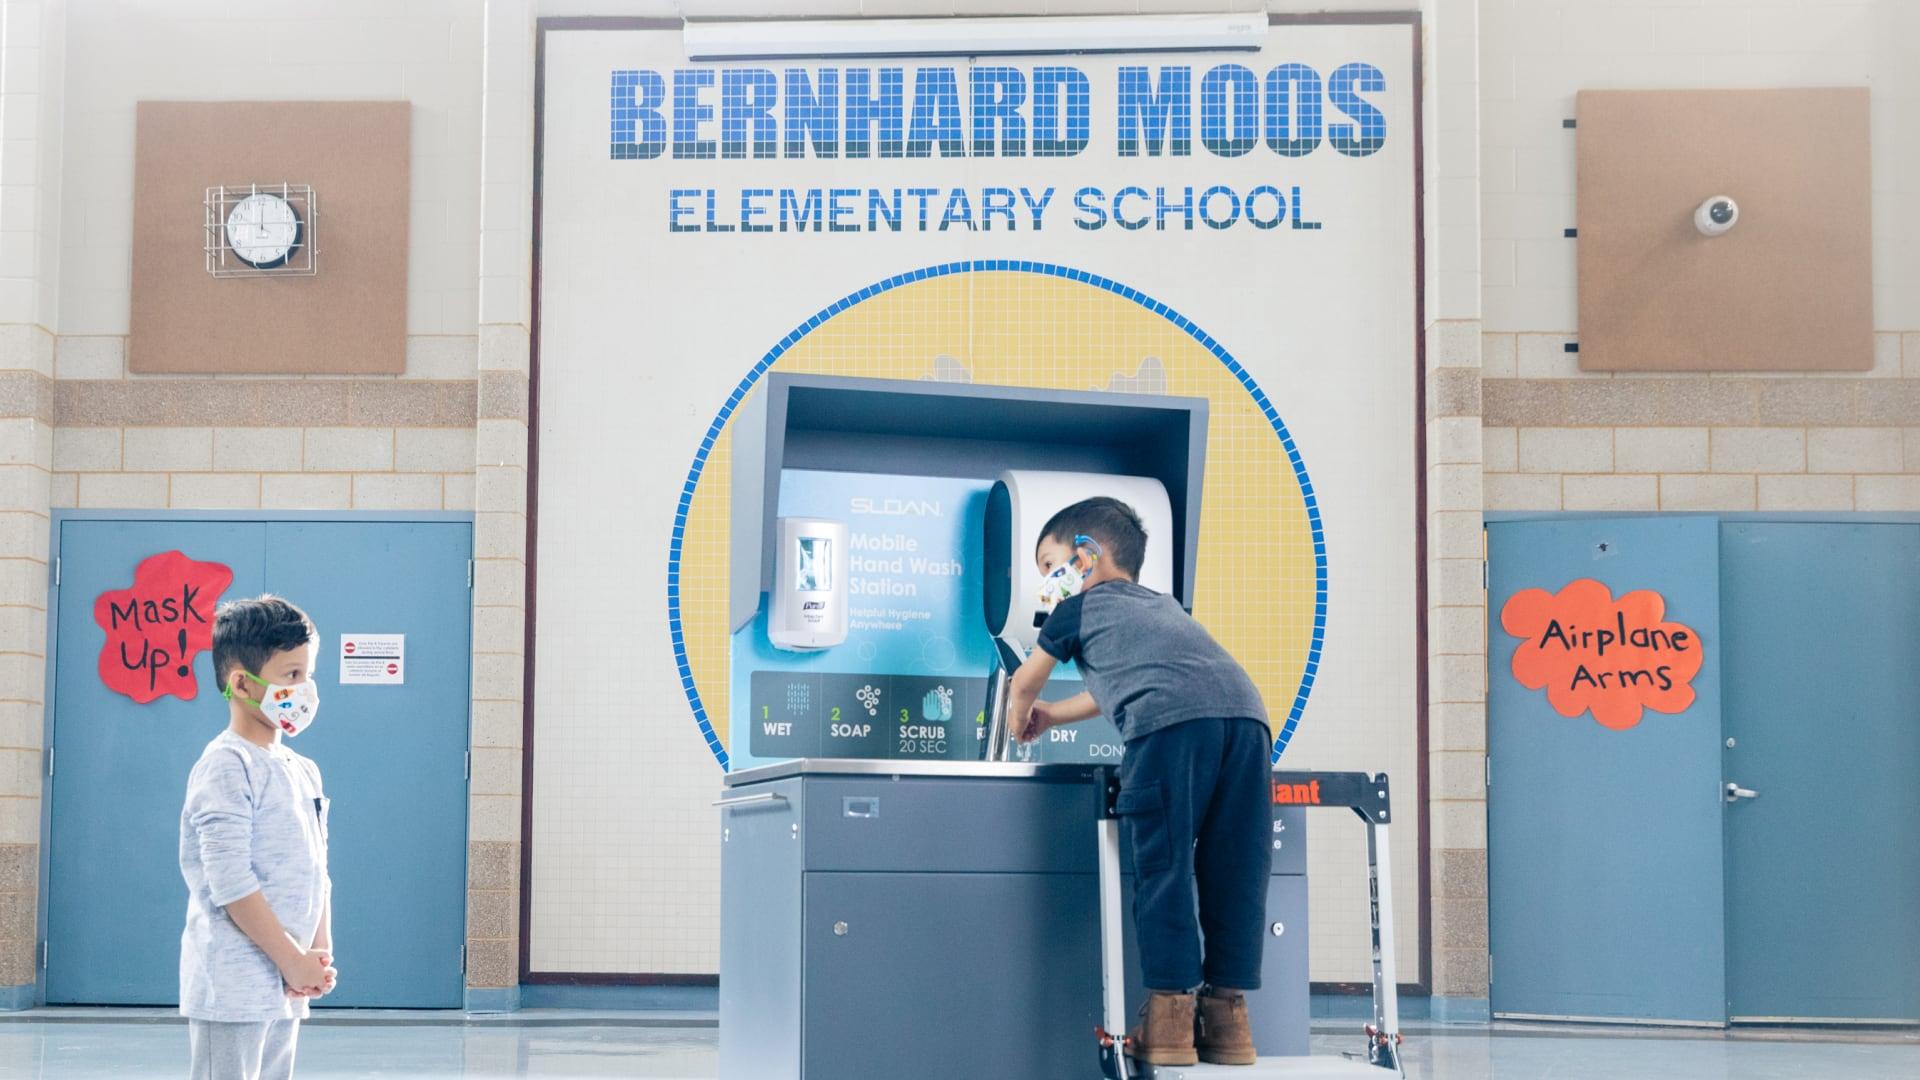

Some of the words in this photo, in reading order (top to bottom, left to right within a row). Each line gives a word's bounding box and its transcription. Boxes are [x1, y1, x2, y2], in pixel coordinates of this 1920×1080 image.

[610, 65, 1090, 160] BERNHARD
[1117, 62, 1387, 158] MOOS
[669, 187, 1057, 232] ELEMENTARY
[1072, 184, 1322, 231] SCHOOL
[850, 498, 942, 517] SLOAN
[850, 533, 918, 552] Mobile
[850, 556, 903, 574] Hand
[909, 556, 963, 576] Wash
[849, 577, 917, 597] Station
[849, 607, 886, 619] Helpful
[888, 608, 932, 621] Hygiene
[849, 620, 903, 631] Anywhere
[1539, 611, 1690, 656] Airplane
[1570, 664, 1673, 691] Arms
[762, 706, 769, 720] 1
[831, 707, 841, 721] 2
[900, 708, 910, 723] 3
[763, 722, 793, 736] WET
[830, 723, 872, 737] SOAP
[899, 725, 946, 739] SCRUB
[1050, 729, 1078, 743] DRY
[899, 740, 916, 753] 20
[919, 740, 947, 754] SEC
